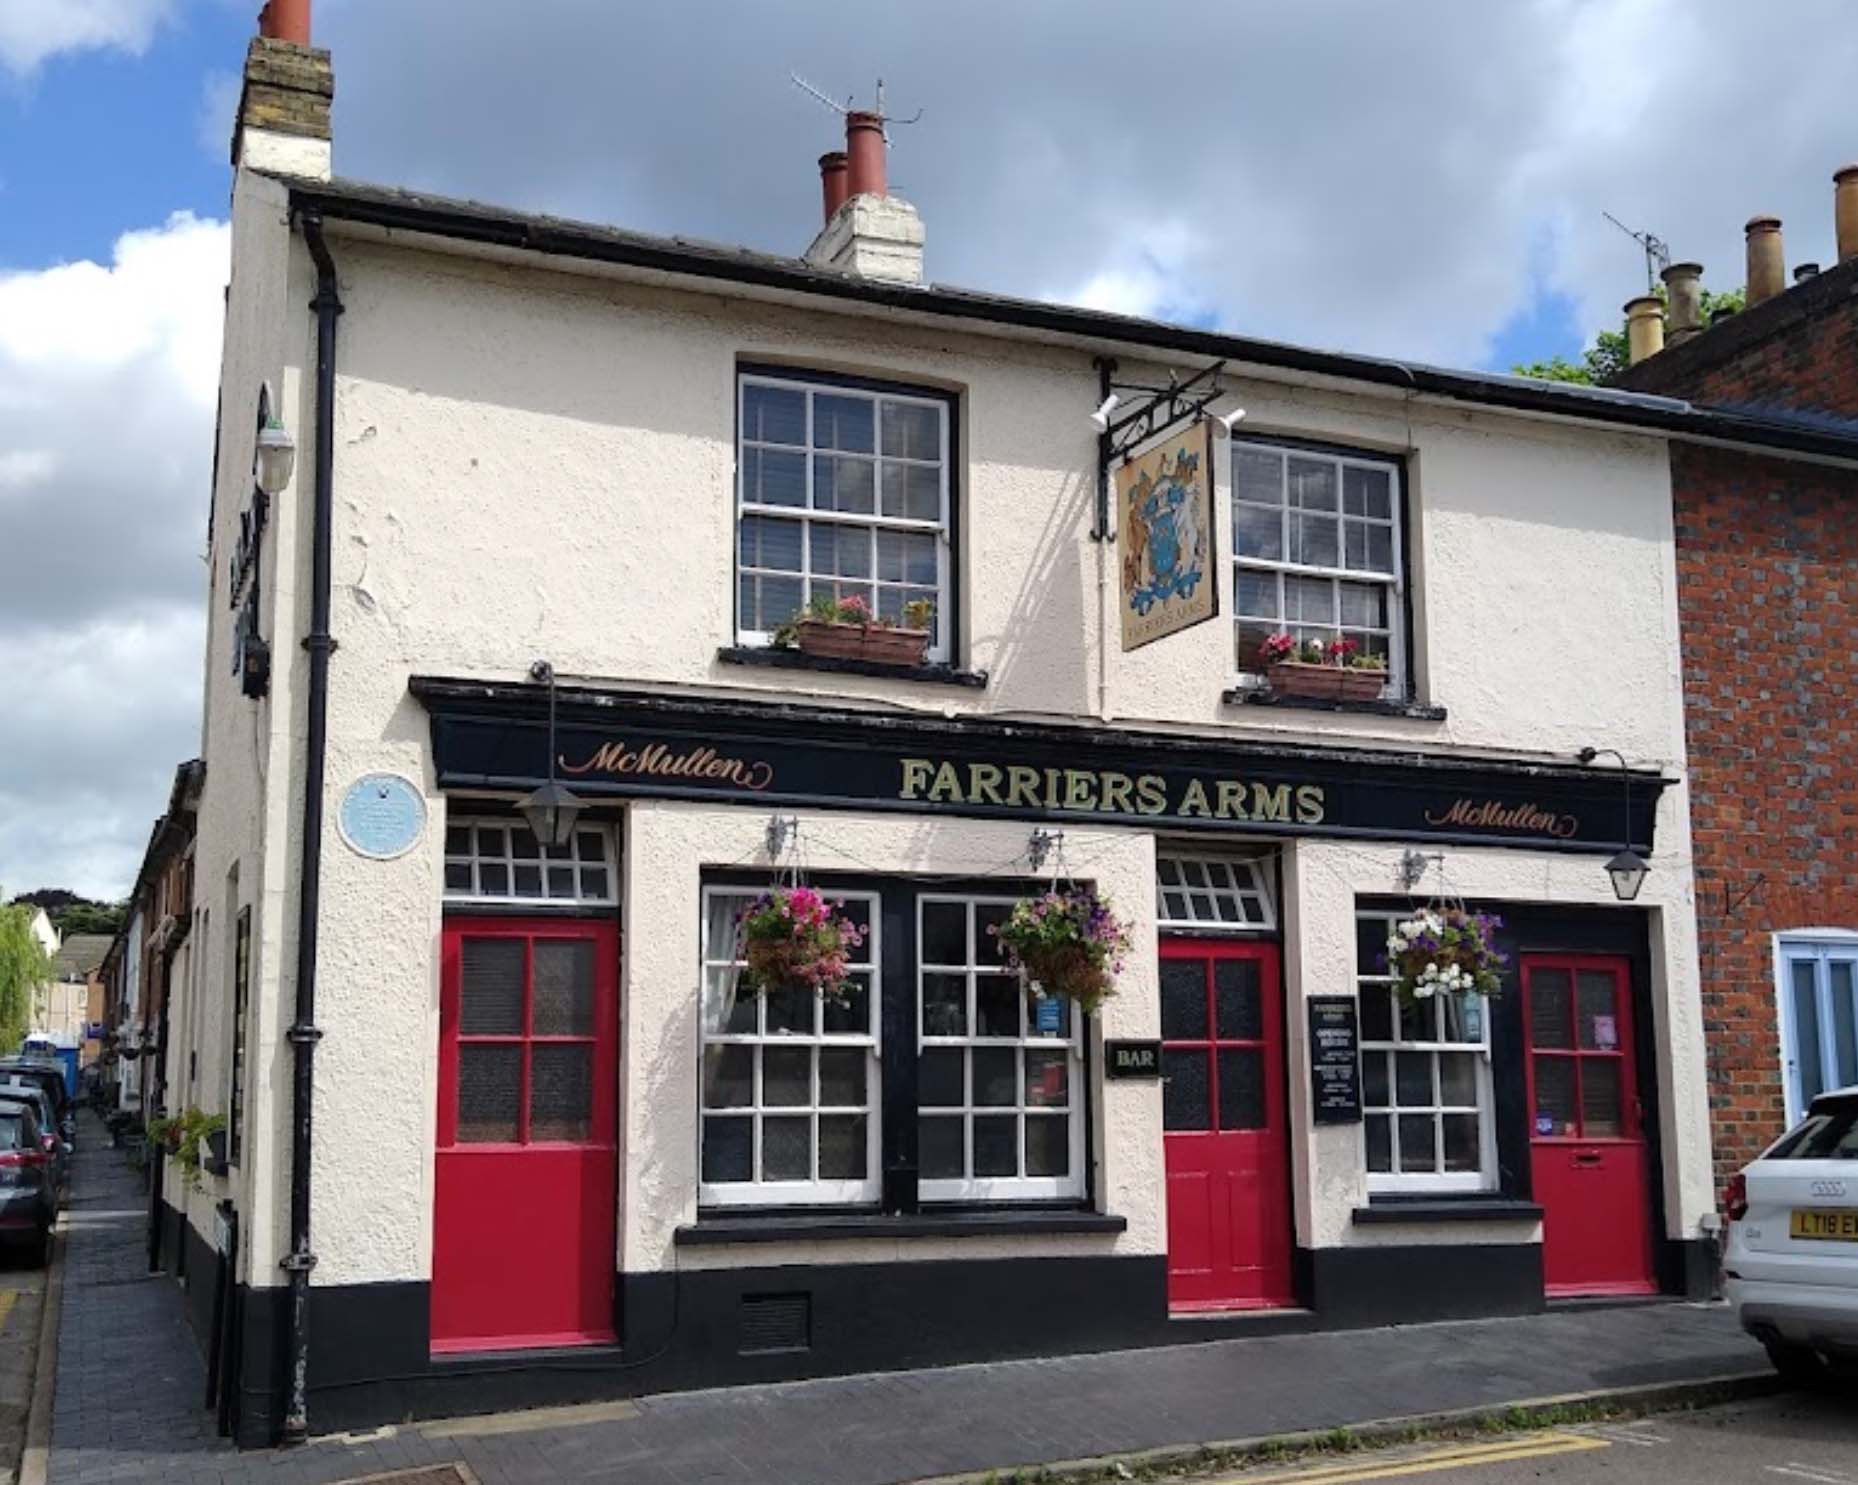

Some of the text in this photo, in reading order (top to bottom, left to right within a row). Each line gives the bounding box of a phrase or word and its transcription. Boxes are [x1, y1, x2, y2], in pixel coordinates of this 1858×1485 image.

[559, 742, 773, 790] McMullen
[900, 758, 1325, 824] FARRIERS ARMS
[1425, 799, 1577, 837] McMullen
[1116, 1049, 1155, 1068] BAR
[1801, 1214, 1836, 1233] LT18
